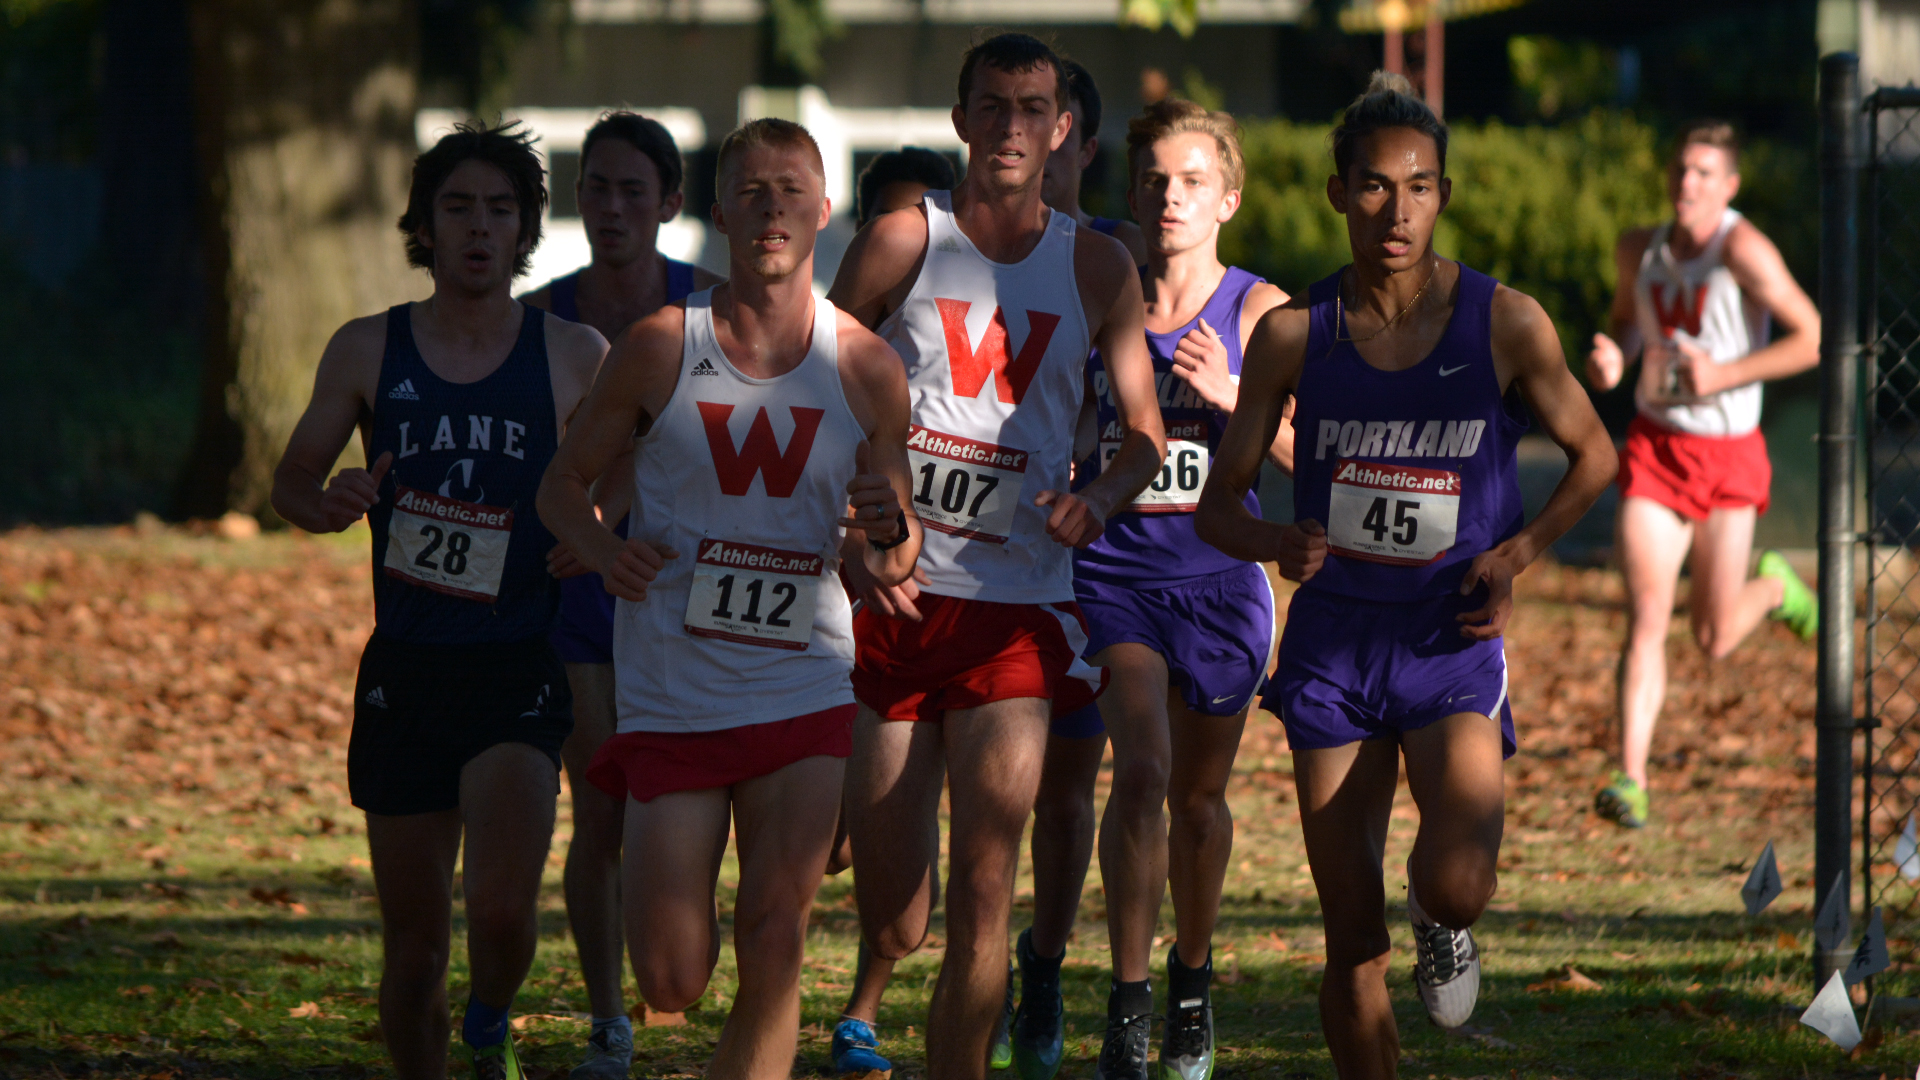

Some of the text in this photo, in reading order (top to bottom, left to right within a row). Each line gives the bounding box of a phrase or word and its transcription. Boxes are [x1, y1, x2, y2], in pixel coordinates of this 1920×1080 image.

[1650, 283, 1709, 339] W
[690, 368, 719, 376] adidas
[933, 297, 1062, 405] W
[388, 391, 420, 400] adidas
[398, 414, 526, 461] LANE
[695, 401, 826, 498] W
[907, 429, 1022, 467] Athletic.net
[1315, 419, 1486, 461] PORTLAND
[913, 461, 1000, 518] 107
[1337, 463, 1455, 491] Athletic.net
[397, 490, 507, 526] Athletic.net
[1362, 496, 1421, 546] 45
[414, 525, 472, 576] 28
[701, 542, 818, 572] Athletic.net
[711, 574, 797, 628] 112
